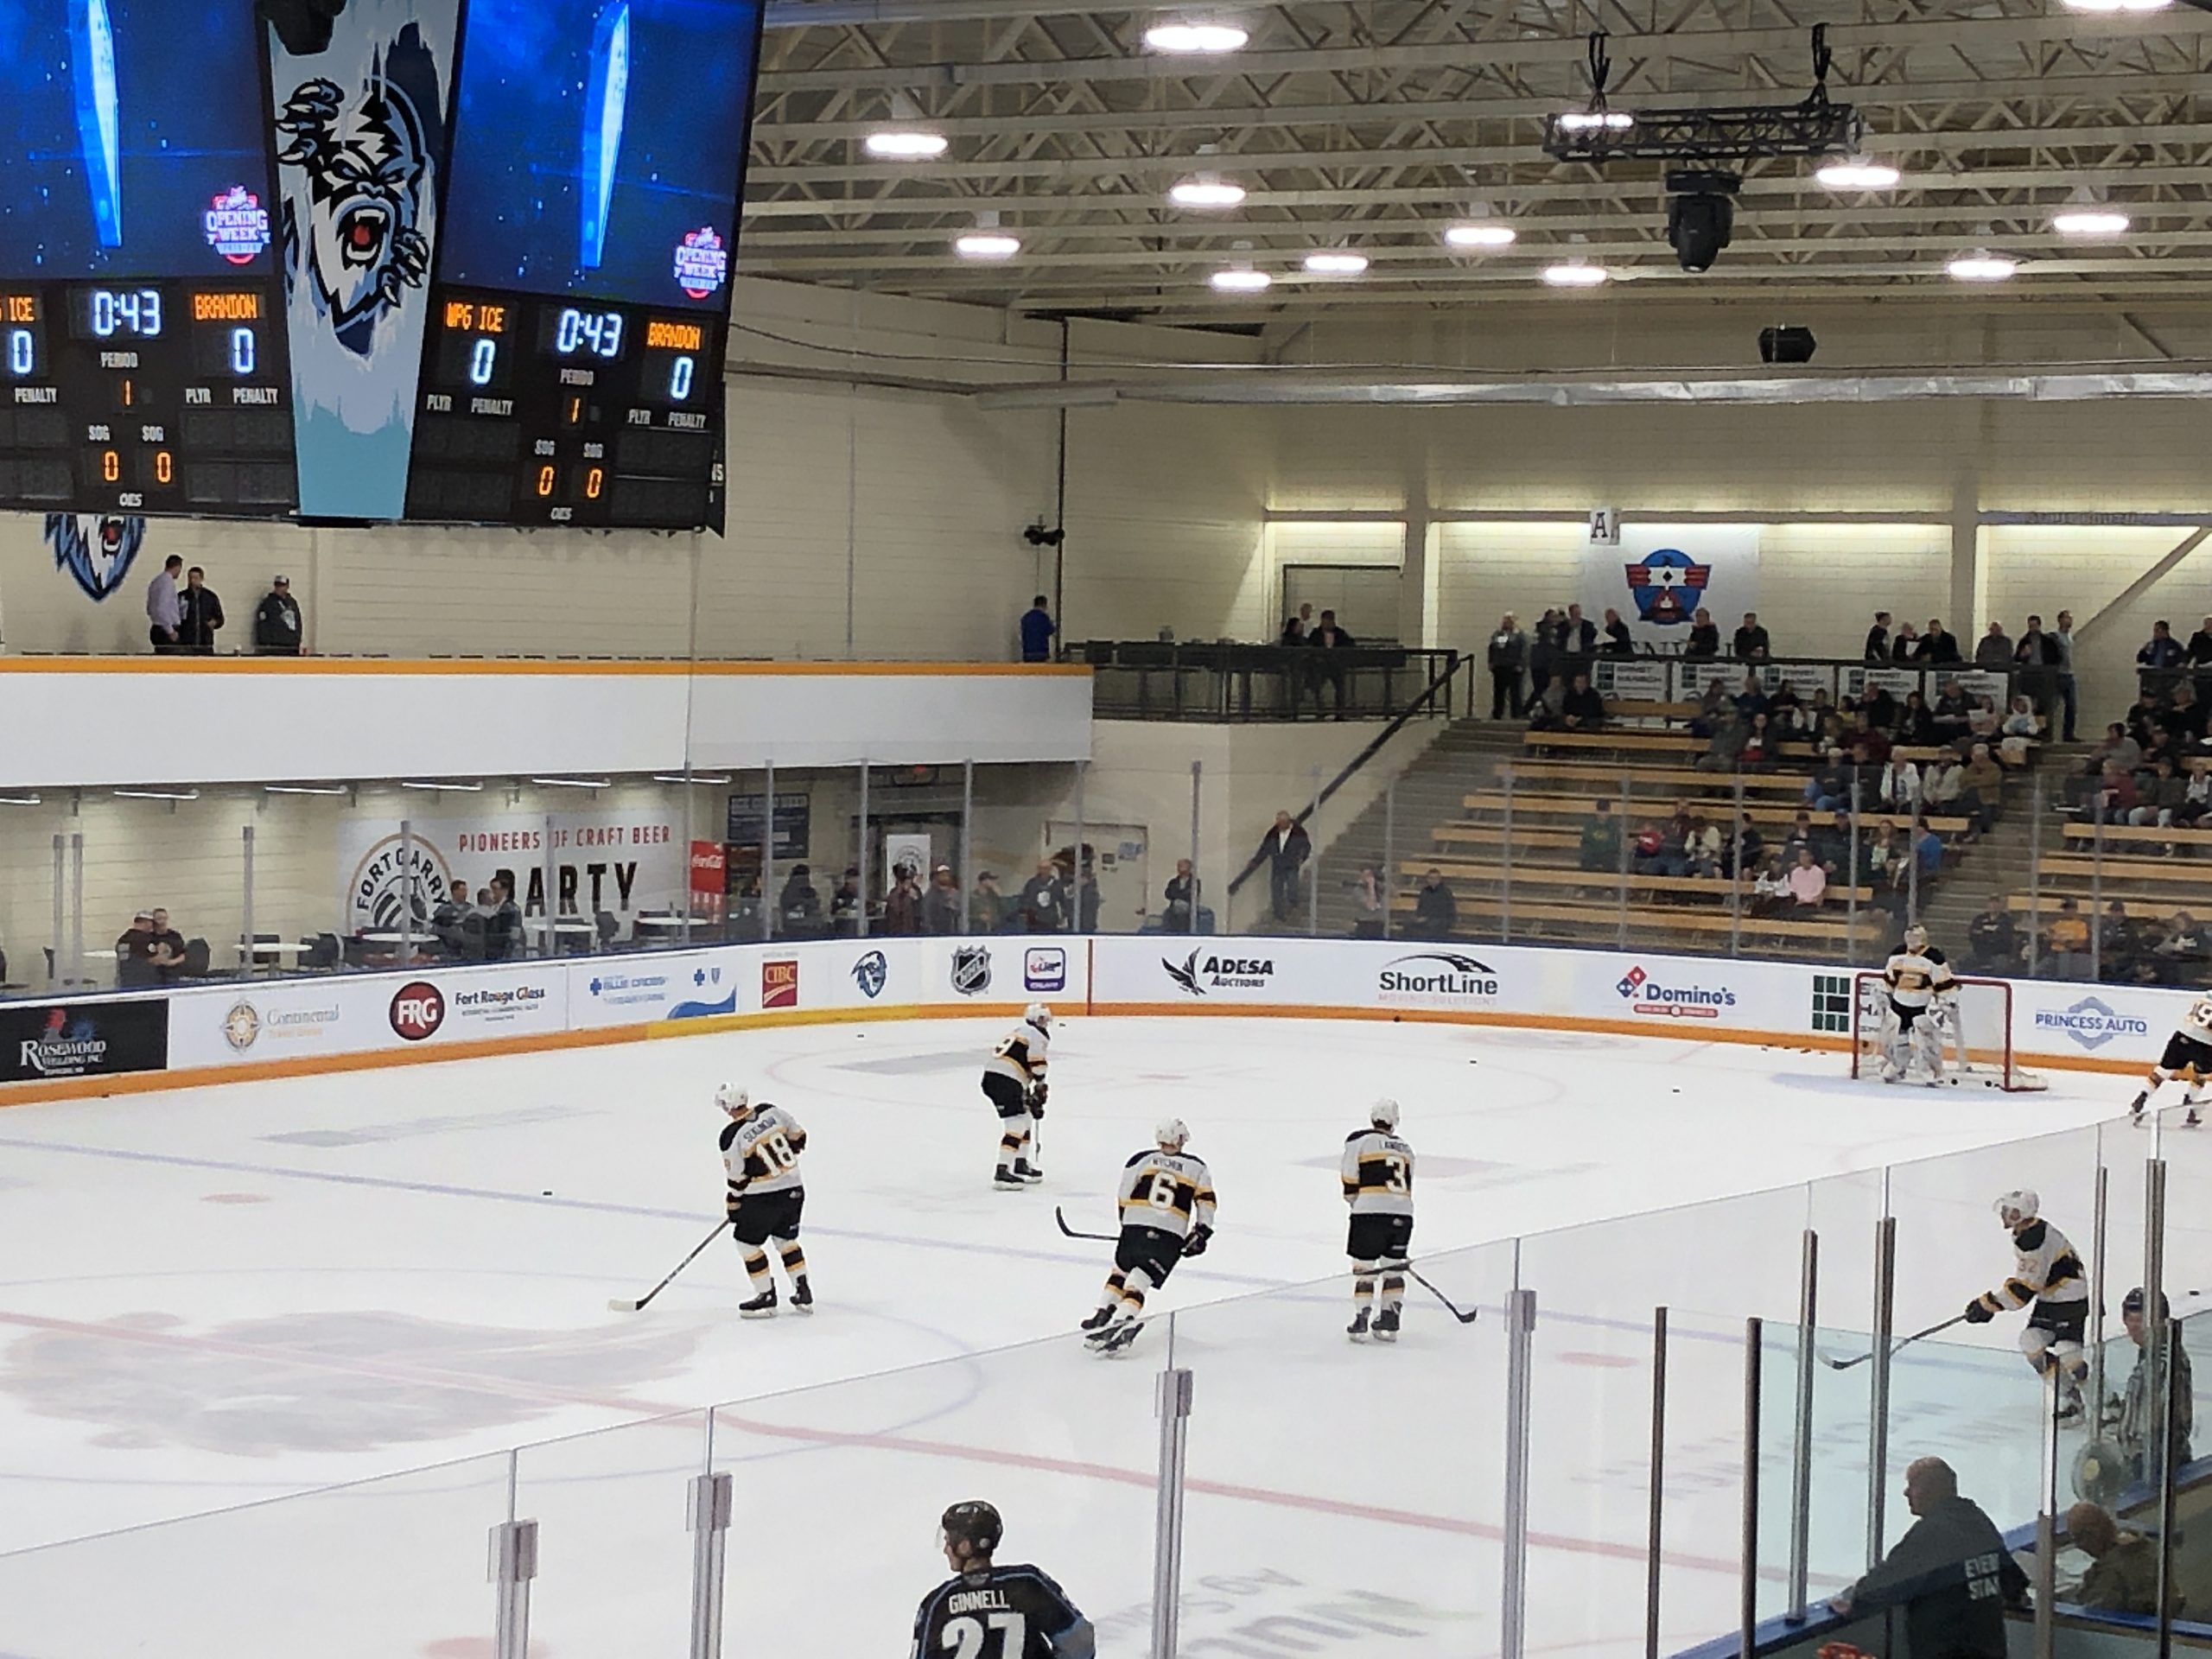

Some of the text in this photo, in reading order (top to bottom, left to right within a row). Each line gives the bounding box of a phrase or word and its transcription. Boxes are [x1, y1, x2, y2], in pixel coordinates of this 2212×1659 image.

[206, 209, 269, 232] OPENING
[218, 226, 259, 241] WEEK
[675, 245, 727, 271] OPENING
[9, 296, 35, 321] ICE
[93, 290, 162, 336] 0:43
[194, 294, 258, 321] BRANDON
[479, 306, 506, 333] ICE
[557, 308, 623, 357] 0:43
[646, 322, 702, 351] BRANDON
[12, 329, 33, 373] 0
[100, 352, 138, 368] PERIOD
[233, 327, 255, 373] 0
[471, 339, 496, 385] 0
[670, 356, 693, 400] 0
[15, 387, 57, 404] PENALTY
[232, 388, 278, 404] PENALTY
[471, 397, 514, 417] PENALTY
[88, 425, 164, 442] SOG SOG
[668, 412, 707, 429] PENALTY
[534, 439, 603, 459] SOG SOG
[105, 450, 119, 482] 0
[156, 451, 171, 484] 0
[538, 465, 555, 497] 0
[587, 468, 602, 499] 0
[1591, 512, 1608, 537] A
[459, 831, 540, 852] PIONEERS
[576, 827, 624, 847] CRAFT
[632, 826, 671, 844] BEER
[357, 852, 395, 910] FORT
[765, 965, 796, 983] CIBC
[1202, 956, 1274, 976] ADESA
[454, 986, 545, 1005] Fort Rouge Glass
[1379, 971, 1498, 995] ShortLine
[1646, 983, 1736, 1006] Domino's
[397, 997, 438, 1030] FRG
[2036, 1014, 2147, 1033] PRINCESS AUTO
[756, 1131, 797, 1176] 18
[1148, 1171, 1178, 1210] 6
[949, 1590, 1010, 1614] GINNELL
[942, 1612, 1026, 1659] 27
